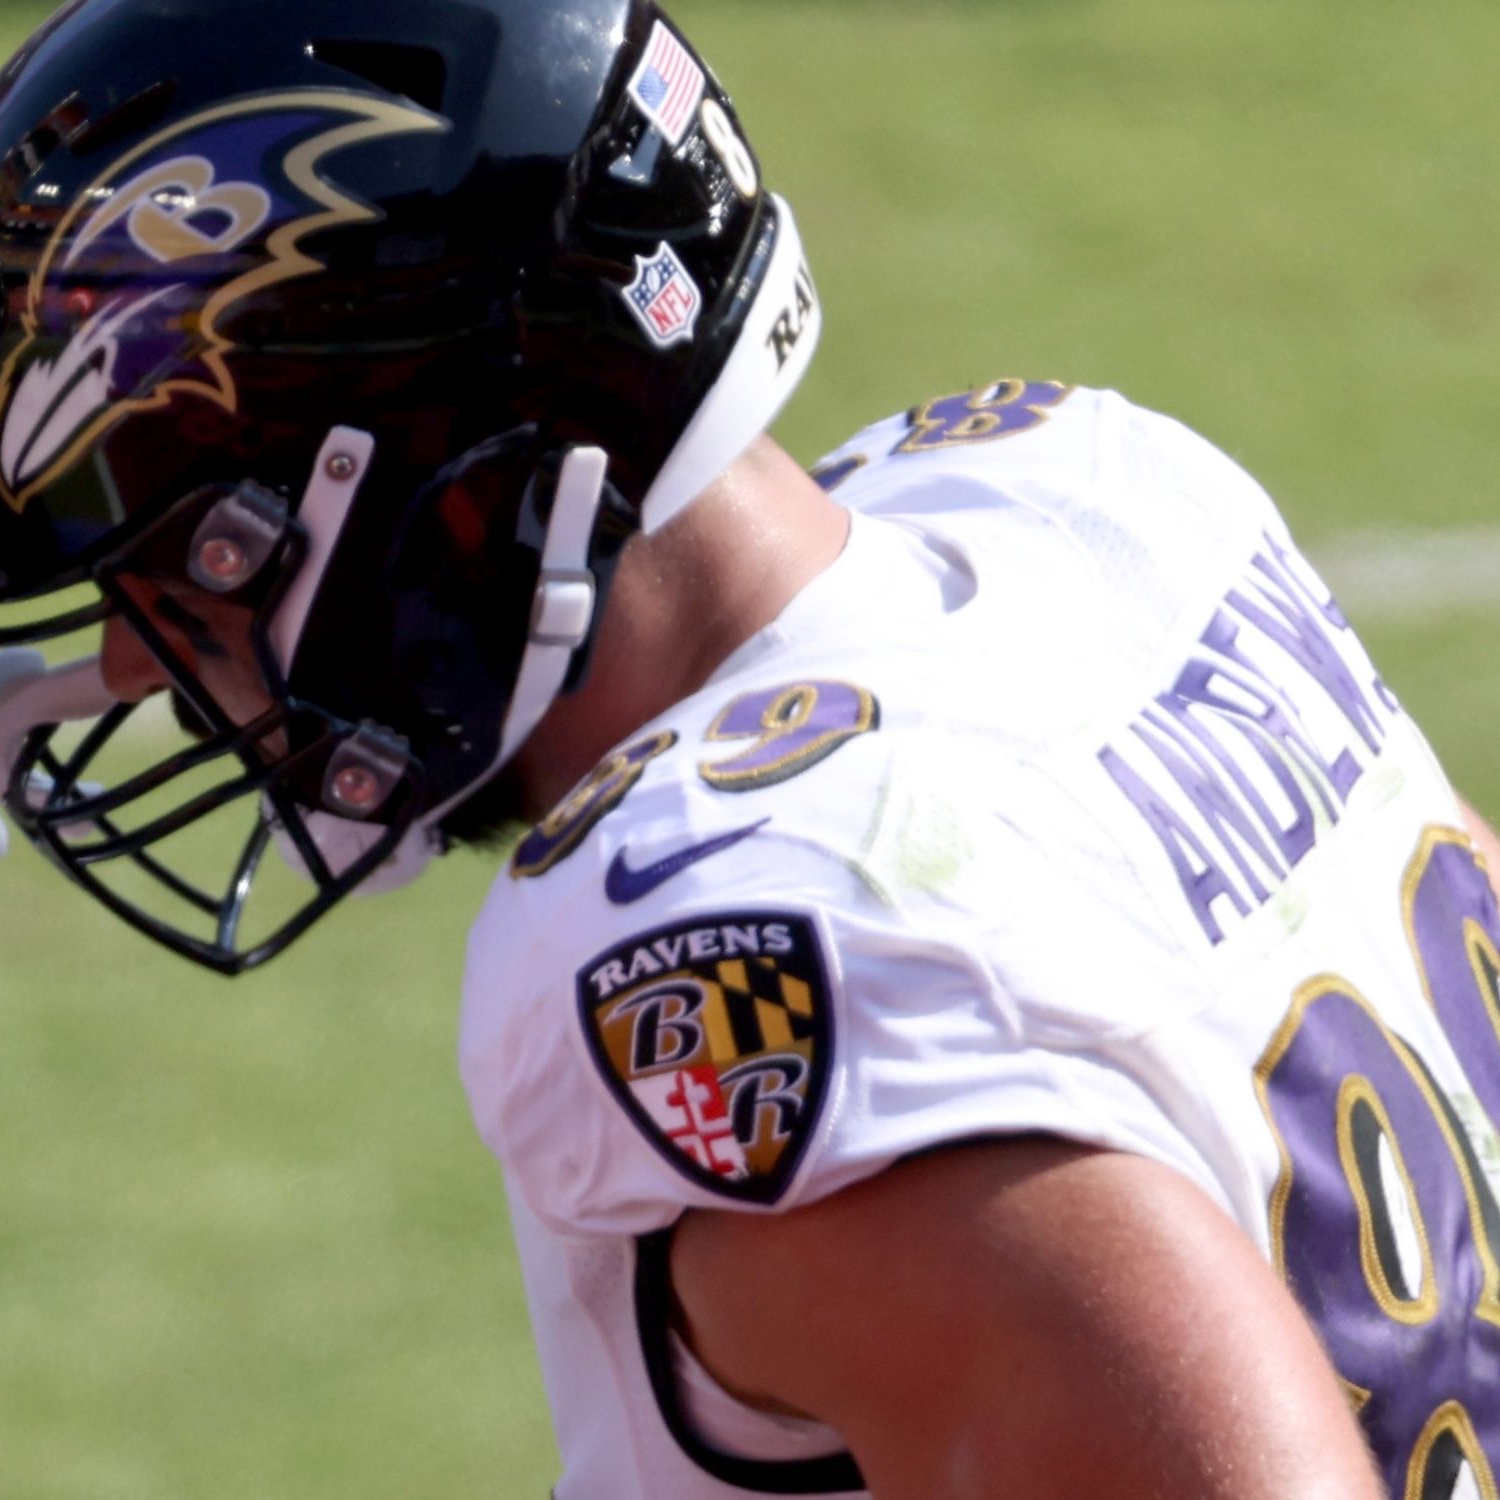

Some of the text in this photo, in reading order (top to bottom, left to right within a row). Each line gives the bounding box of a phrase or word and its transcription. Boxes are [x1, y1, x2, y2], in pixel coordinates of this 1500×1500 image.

[63, 155, 272, 268] B
[647, 278, 694, 335] NFL
[510, 680, 882, 880] 89
[590, 922, 795, 997] RAVENS
[601, 976, 707, 1074] B
[717, 1055, 806, 1147] R
